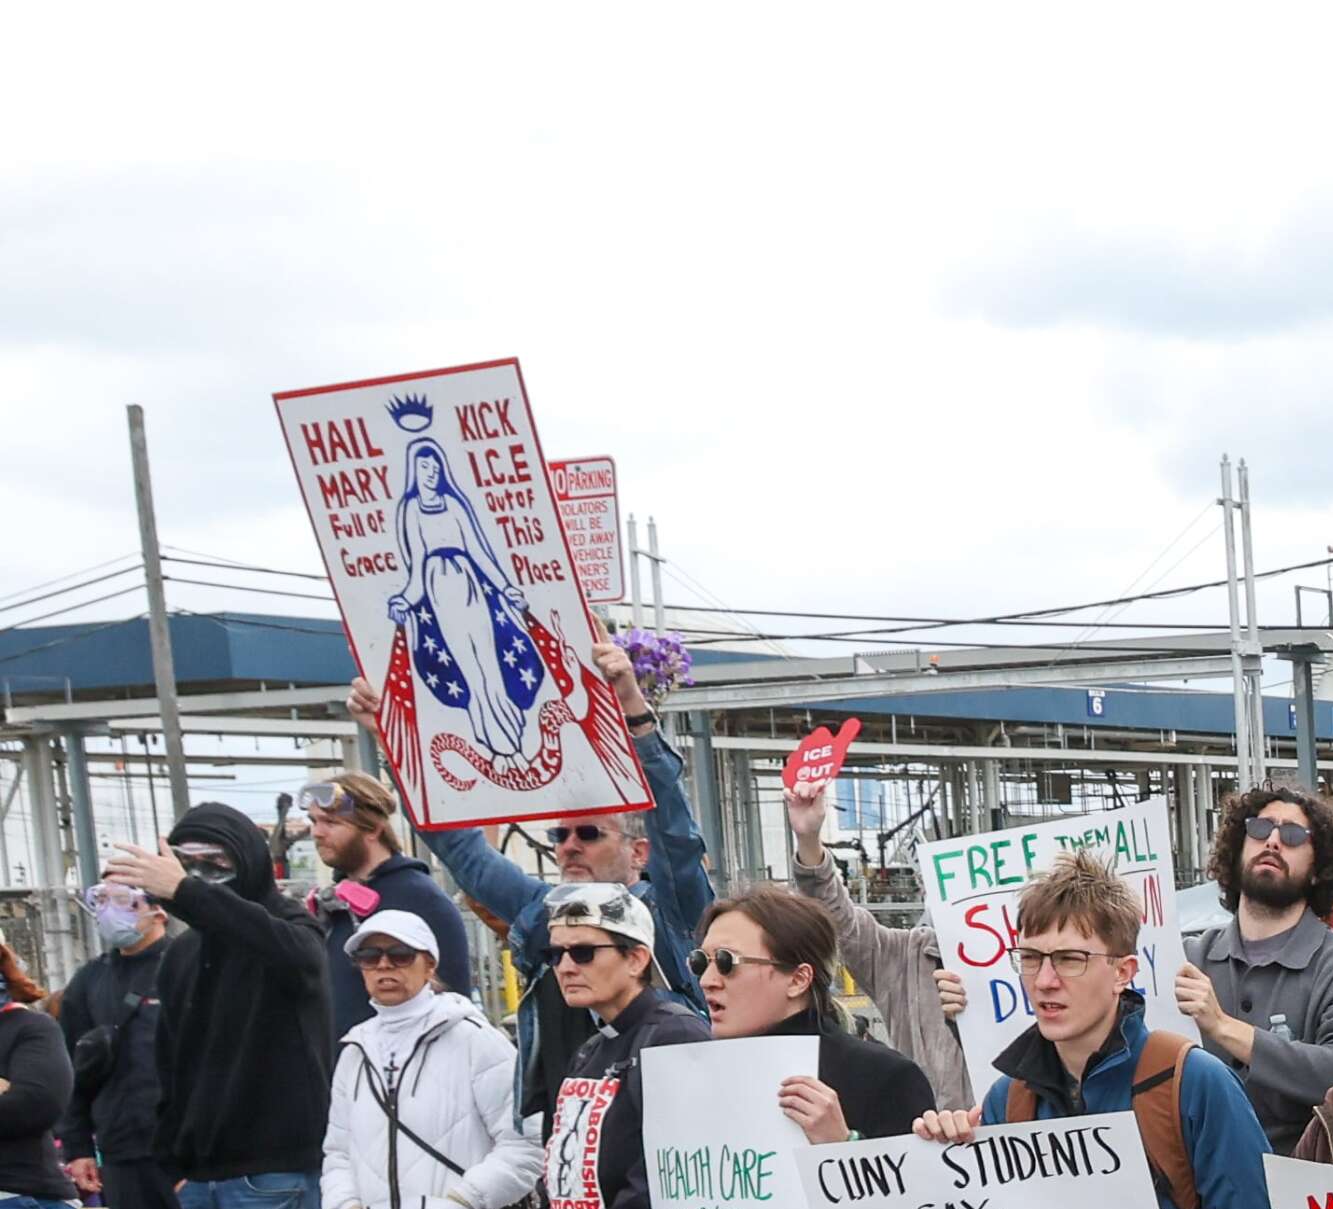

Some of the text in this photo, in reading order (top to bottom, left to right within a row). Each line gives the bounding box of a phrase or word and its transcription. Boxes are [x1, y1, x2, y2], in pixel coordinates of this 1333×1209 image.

[455, 398, 518, 442] KICK
[300, 417, 384, 466] HAIL
[468, 443, 532, 488] I.C.E
[317, 466, 392, 509] MARY
[552, 468, 612, 495] O PARKING
[561, 500, 608, 516] IOLATORS
[589, 517, 603, 530] BE
[496, 517, 545, 548] This
[589, 531, 615, 545] AWAY
[340, 547, 398, 578] Grace
[573, 546, 614, 561] VEHICLE
[511, 553, 565, 586] Place
[578, 563, 609, 576] NER'S
[1093, 696, 1103, 714] 6
[802, 745, 832, 762] ICE
[796, 762, 834, 781] OUT
[1054, 826, 1110, 850] THEM
[1114, 817, 1158, 868] ALL
[581, 1096, 608, 1198] ABOLISH
[657, 1144, 777, 1201] HEALTH CARE
[817, 1127, 1121, 1203] CUNY STUDENTS
